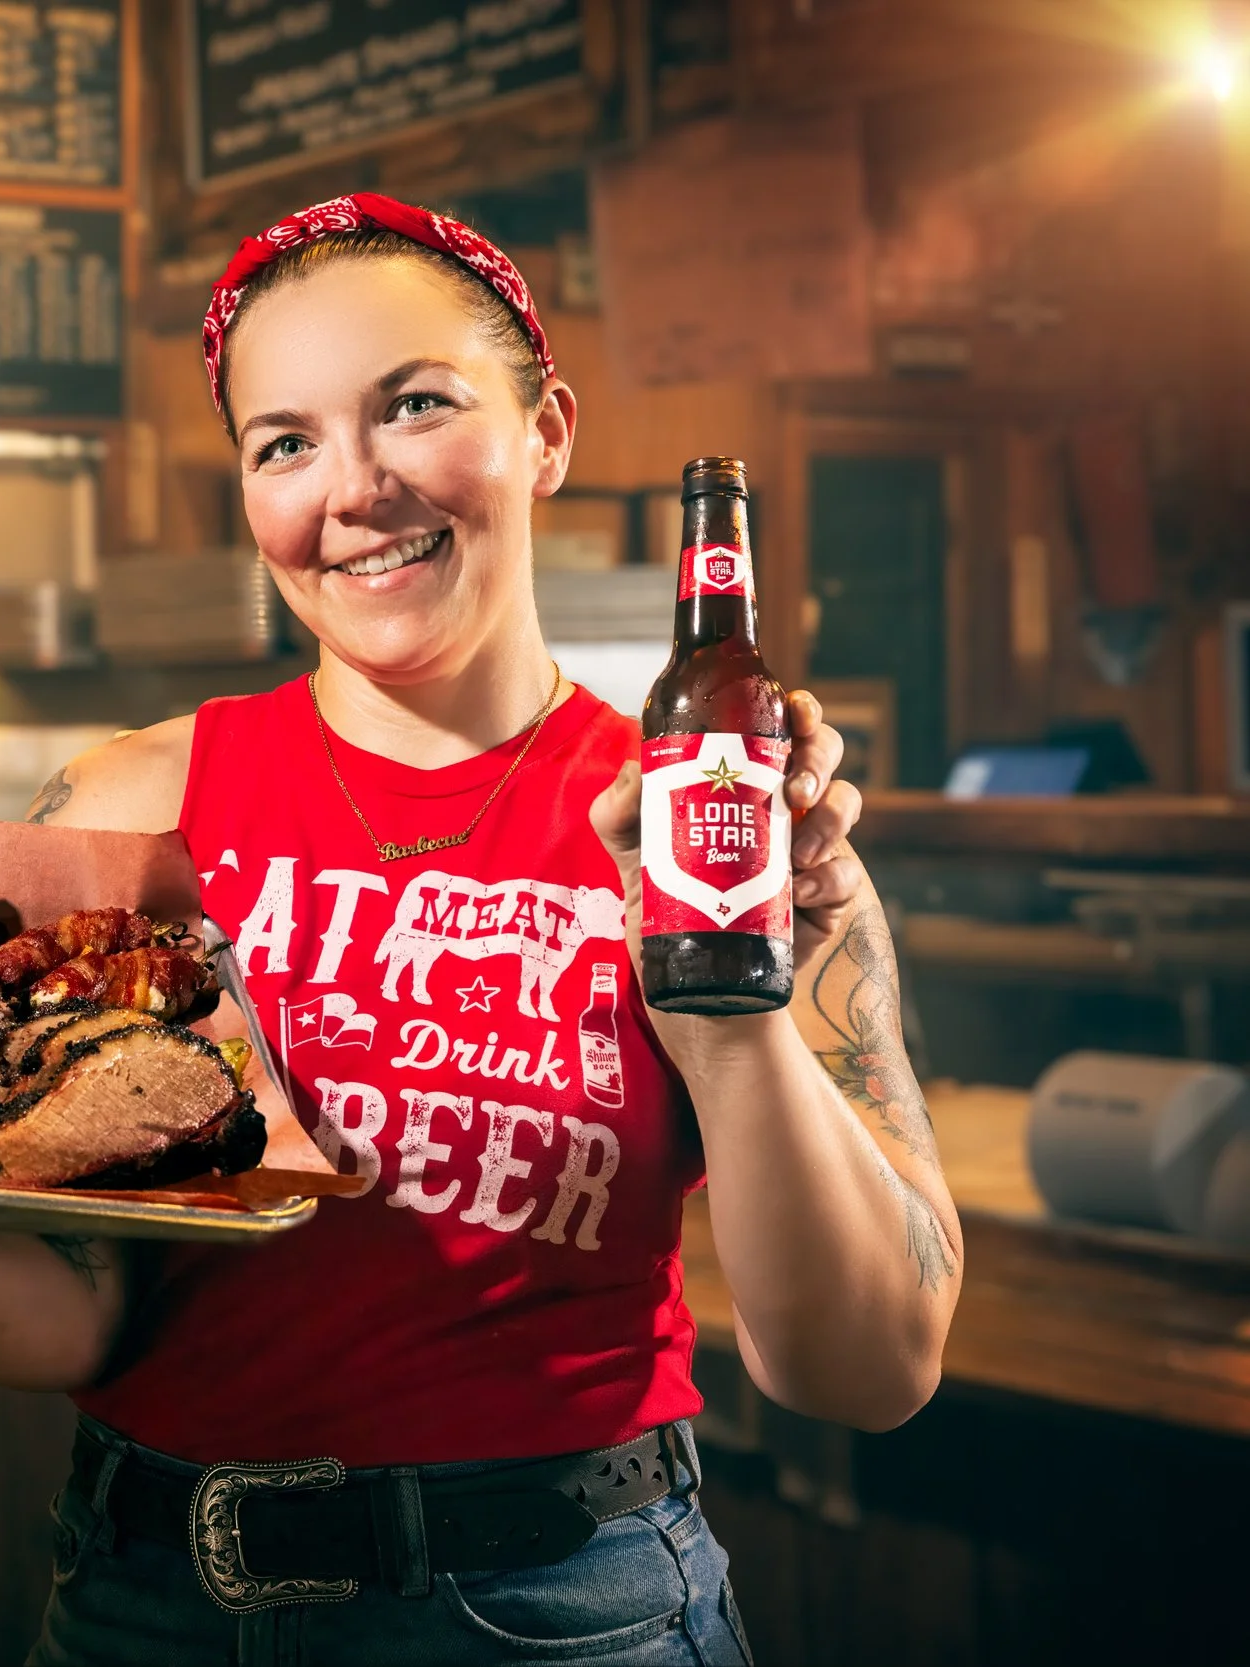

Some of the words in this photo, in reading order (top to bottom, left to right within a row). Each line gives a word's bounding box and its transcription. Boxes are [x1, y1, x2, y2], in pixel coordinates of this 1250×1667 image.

[710, 561, 731, 569] LONE
[688, 802, 755, 824] LONE
[379, 831, 469, 862] Barbecue
[688, 826, 756, 848] STAR
[705, 847, 741, 864] Beer
[198, 848, 390, 985] AT
[409, 885, 578, 951] MEAT
[391, 1019, 570, 1090] Drink
[585, 1048, 617, 1063] Shiner
[312, 1077, 621, 1250] BEER
